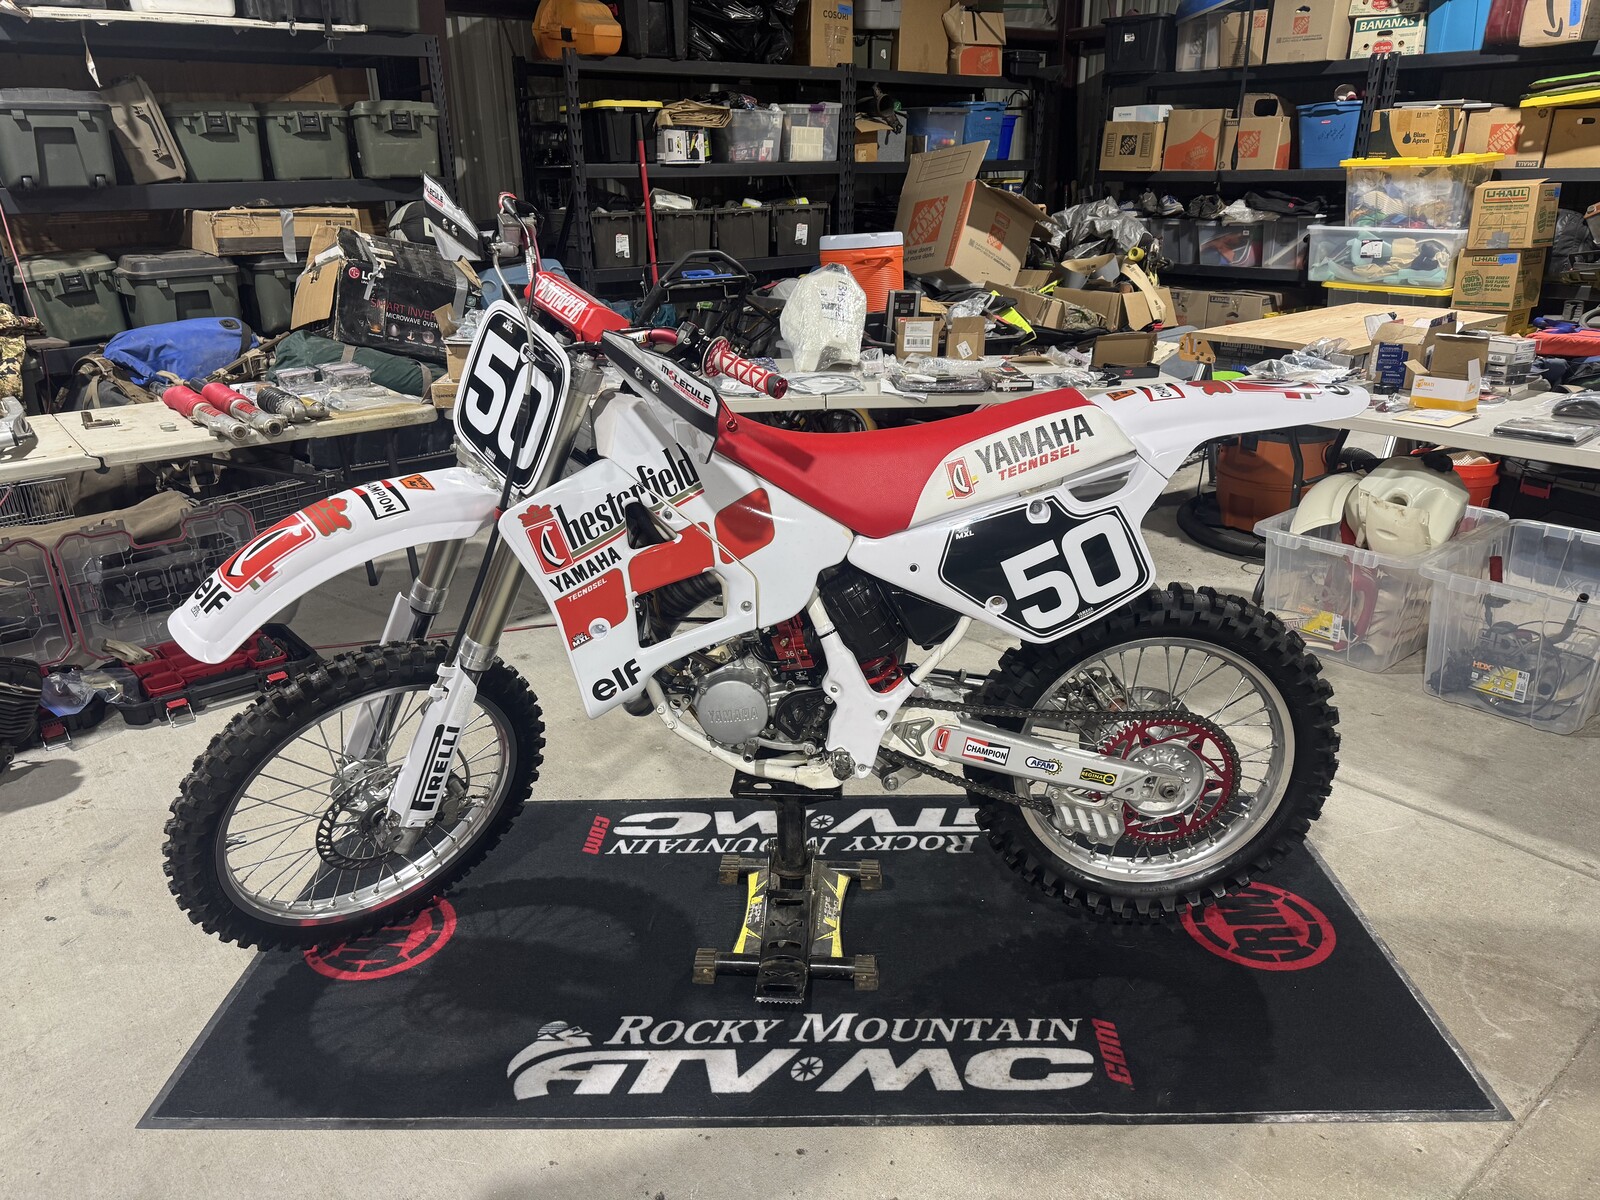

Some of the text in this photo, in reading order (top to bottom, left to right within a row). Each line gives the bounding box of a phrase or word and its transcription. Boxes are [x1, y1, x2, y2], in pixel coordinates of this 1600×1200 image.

[823, 9, 849, 20] COSORI
[1360, 16, 1415, 31] BANANAS
[1486, 189, 1527, 199] U-HAUL
[1474, 255, 1497, 263] U-HAU
[370, 297, 405, 313] SMART
[386, 312, 439, 329] MICROWAVE OVEN
[661, 364, 711, 405] MOLECULE
[466, 328, 555, 470] 50
[974, 413, 1095, 474] YAMAHA
[998, 444, 1080, 481] TECNOSEL
[364, 482, 397, 513] AMPION
[955, 530, 974, 540] MXL
[549, 546, 622, 593] YAMAHA
[1000, 515, 1140, 629] 50
[194, 577, 232, 615] elf
[567, 578, 608, 602] TECNOSEL
[572, 634, 591, 648] MXL
[784, 651, 795, 659] 36
[1472, 660, 1494, 671] HDX
[592, 658, 642, 701] elf
[708, 706, 759, 724] YAMAHA
[965, 744, 1009, 760] CHAMPION
[410, 723, 461, 811] PIRELLI
[1030, 758, 1056, 771] AFAM
[1081, 768, 1103, 781] REGINA
[603, 1013, 1082, 1045] ROCKY MOUNTAIN
[513, 1048, 1094, 1100] ATV MC
